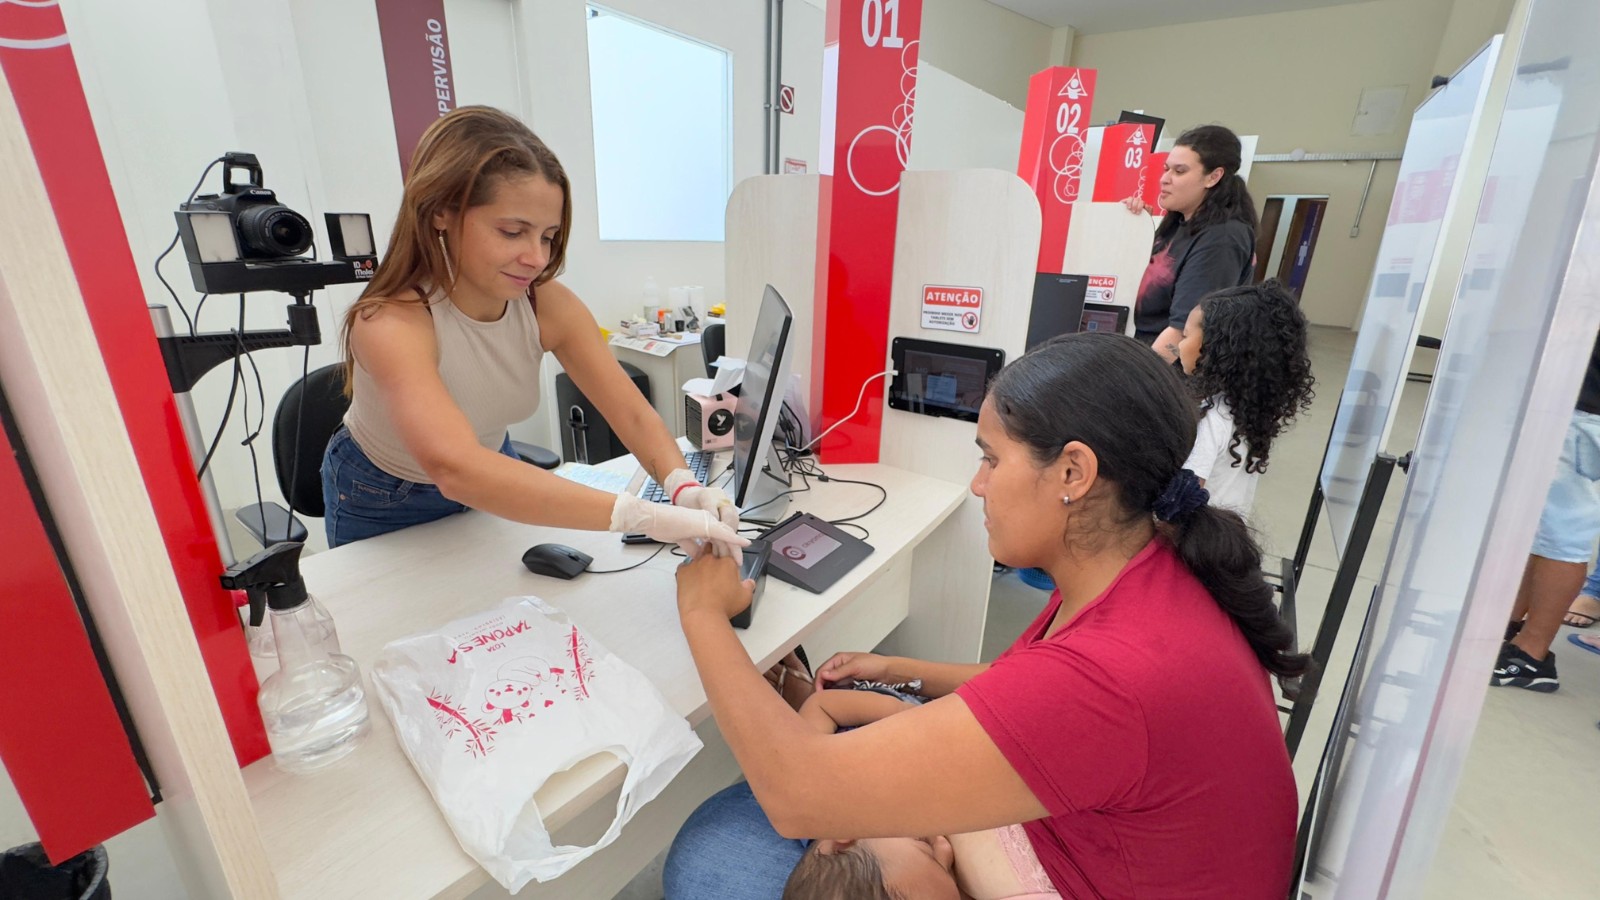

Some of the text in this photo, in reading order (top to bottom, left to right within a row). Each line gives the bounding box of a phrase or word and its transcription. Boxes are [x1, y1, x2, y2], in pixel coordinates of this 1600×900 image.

[862, 0, 904, 48] 01
[425, 18, 452, 117] PERVISÃO
[1056, 102, 1082, 134] 02
[1125, 147, 1143, 169] 03
[1089, 278, 1115, 287] ENÇÃO
[926, 291, 979, 305] ATENÇÃO
